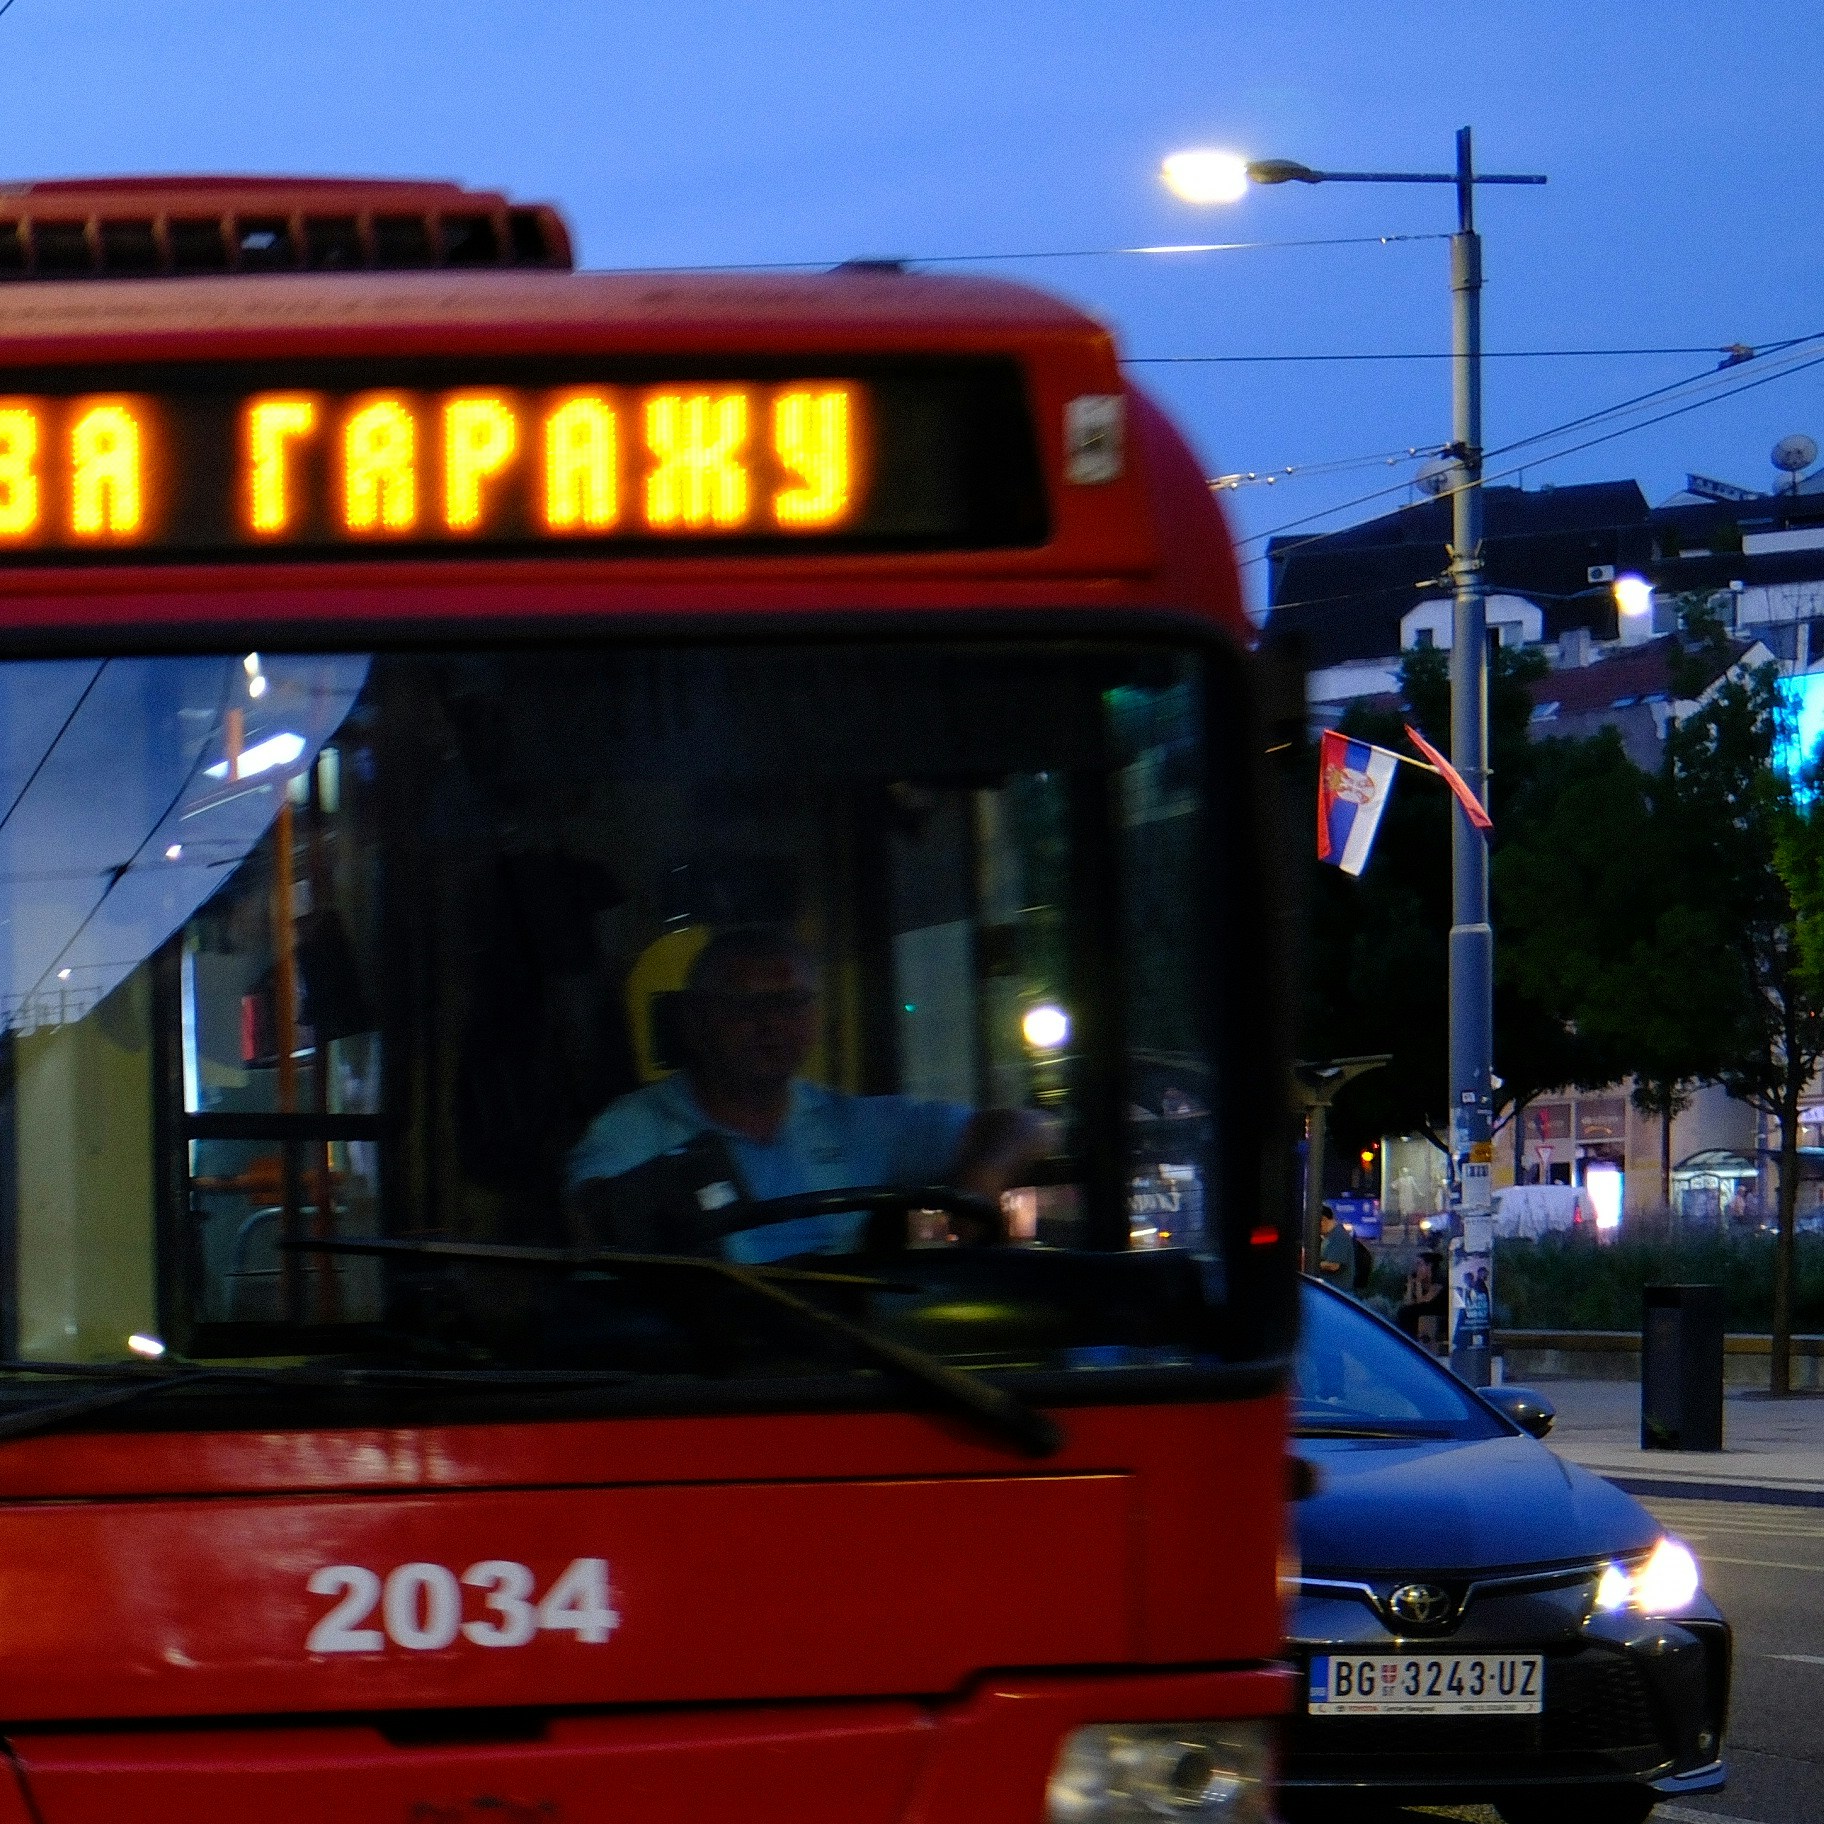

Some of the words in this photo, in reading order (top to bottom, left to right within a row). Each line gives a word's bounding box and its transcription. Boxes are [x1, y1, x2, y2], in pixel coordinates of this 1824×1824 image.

[247, 387, 852, 533] ГАРАЖУ
[305, 1557, 621, 1653] 2034
[1335, 1661, 1375, 1696] BG
